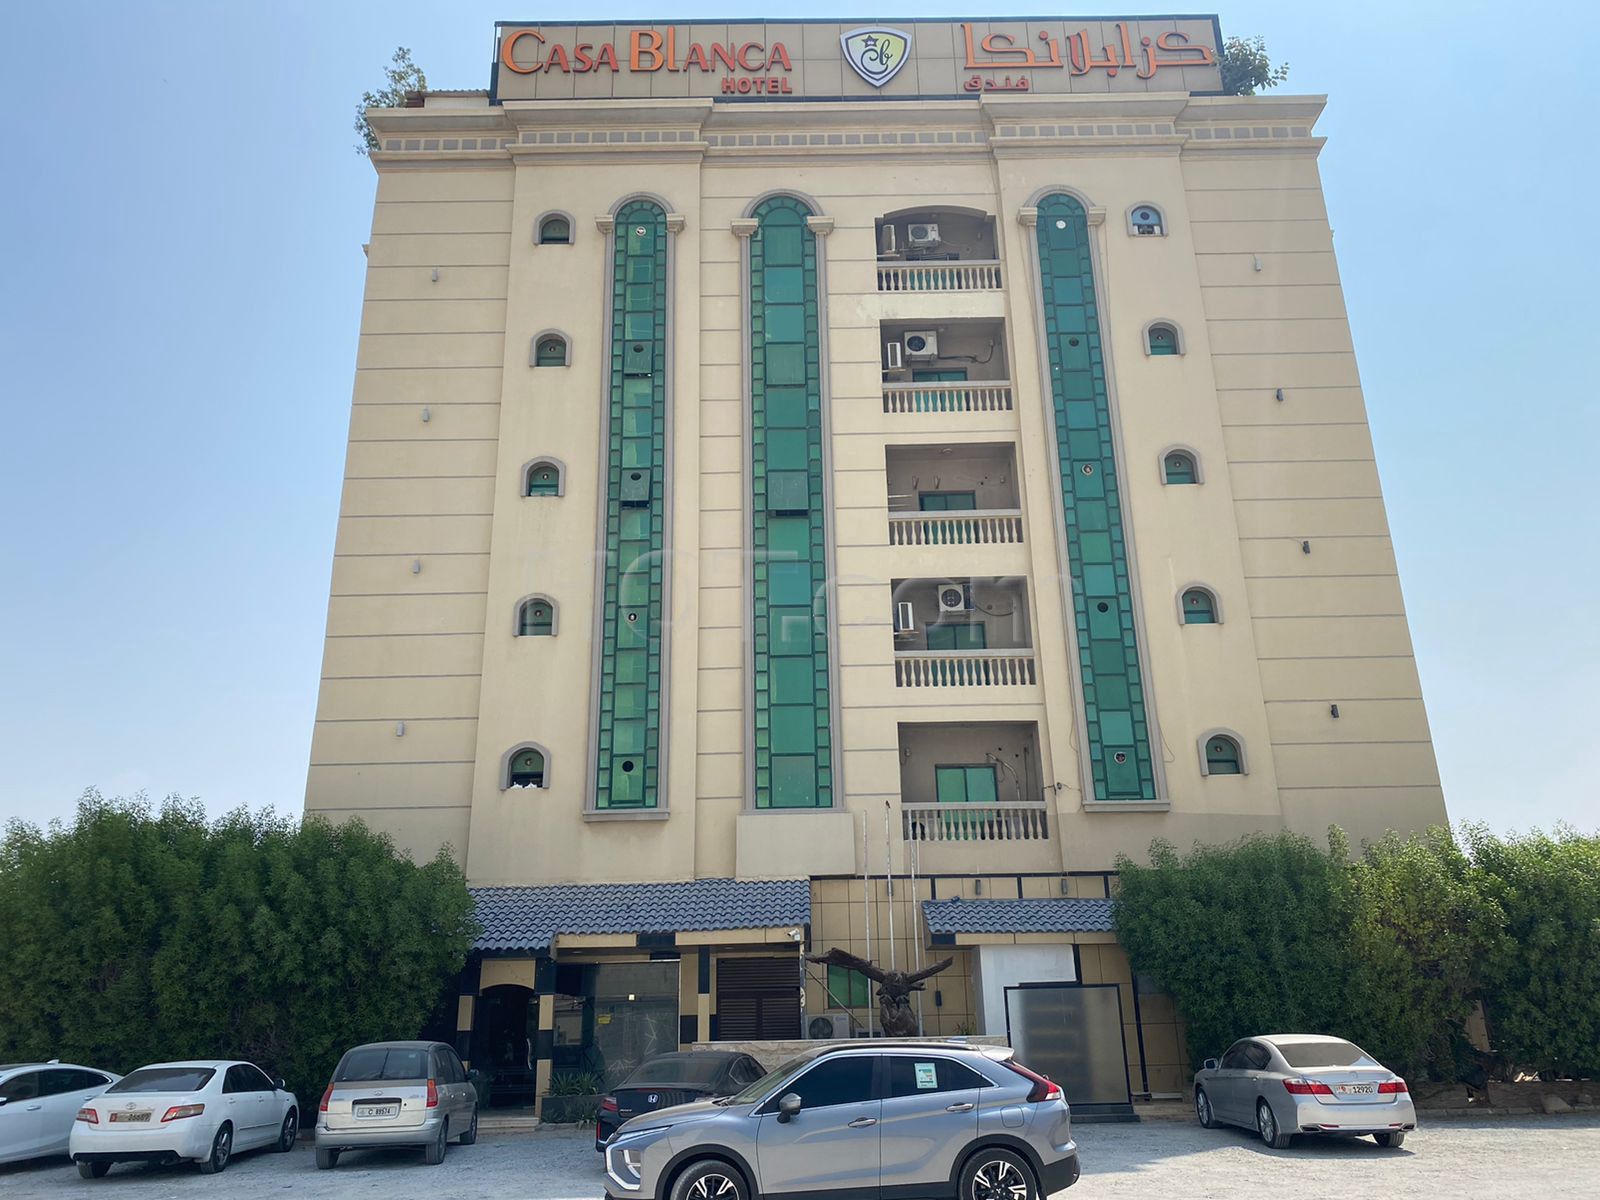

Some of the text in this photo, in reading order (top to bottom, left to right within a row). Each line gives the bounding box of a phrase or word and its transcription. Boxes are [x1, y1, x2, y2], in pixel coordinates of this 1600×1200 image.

[502, 29, 619, 74] CASA
[722, 77, 793, 95] HOTEL
[964, 74, 1030, 92] فندق
